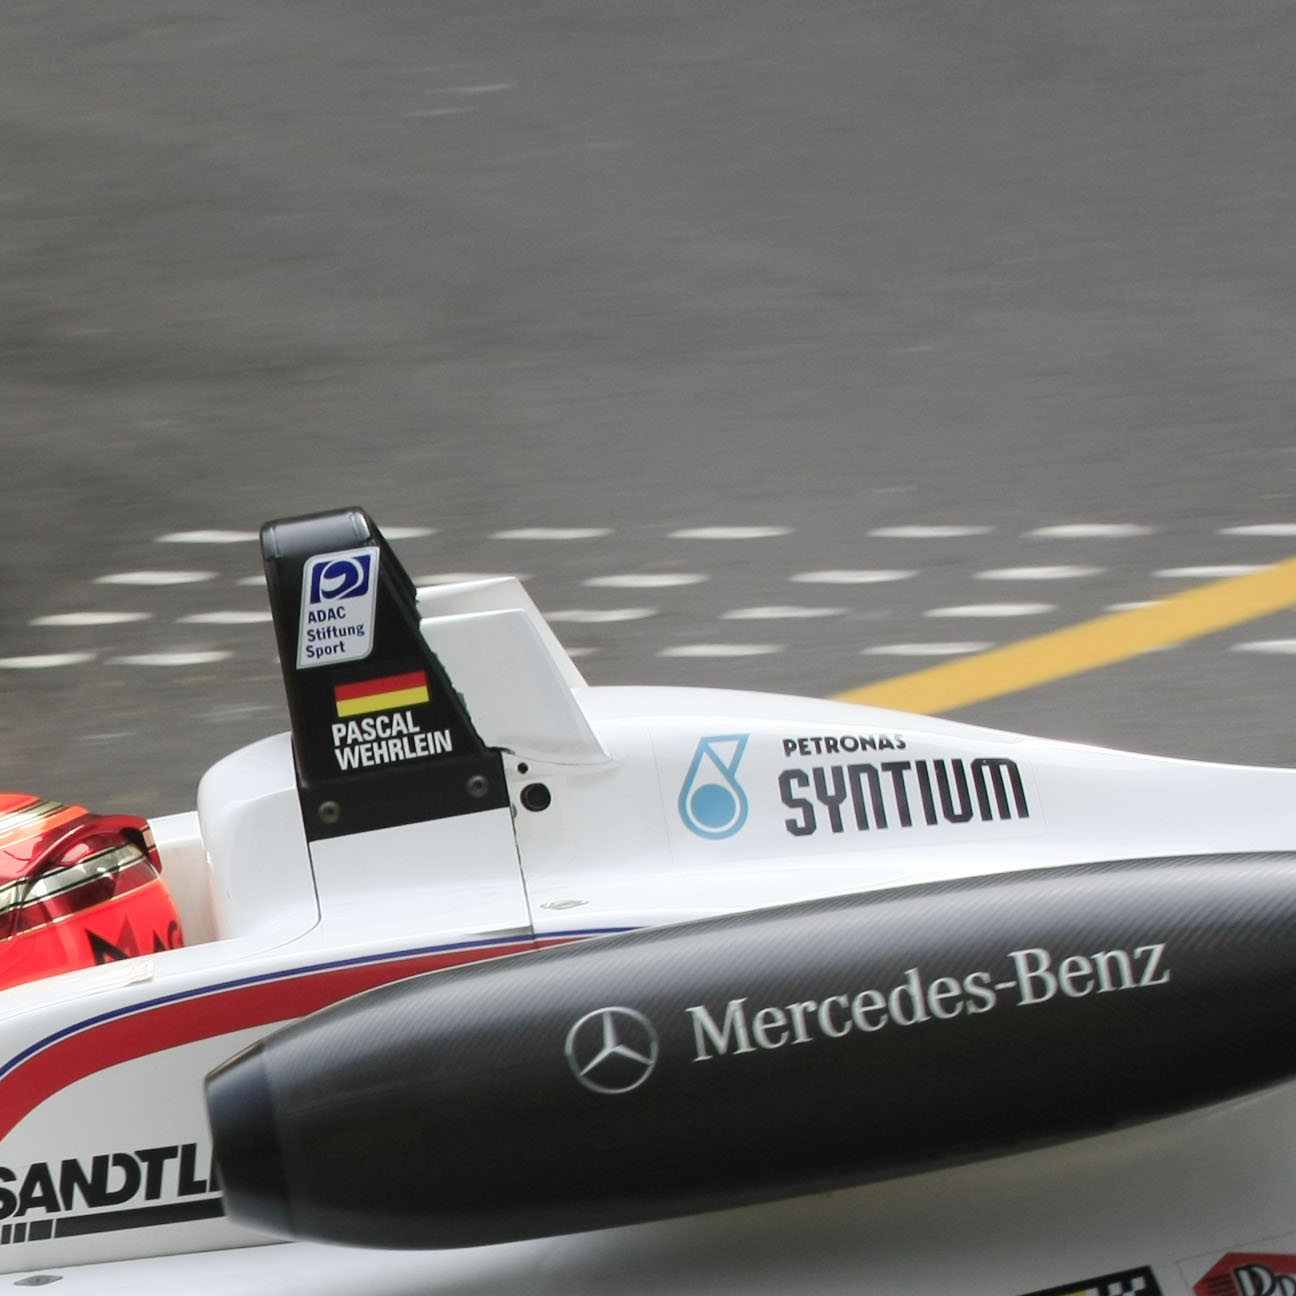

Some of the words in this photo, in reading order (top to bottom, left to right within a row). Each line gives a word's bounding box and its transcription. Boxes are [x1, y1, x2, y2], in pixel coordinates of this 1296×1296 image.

[307, 606, 346, 625] ADAC
[306, 623, 365, 642] Stiftung
[305, 641, 346, 660] Sport
[331, 711, 420, 747] PASCAL
[334, 729, 453, 771] WEHRLEIN
[783, 734, 907, 757] PETRONAS
[778, 757, 1030, 837] SYNTIUM
[685, 943, 1171, 1062] Mercedes-Benz
